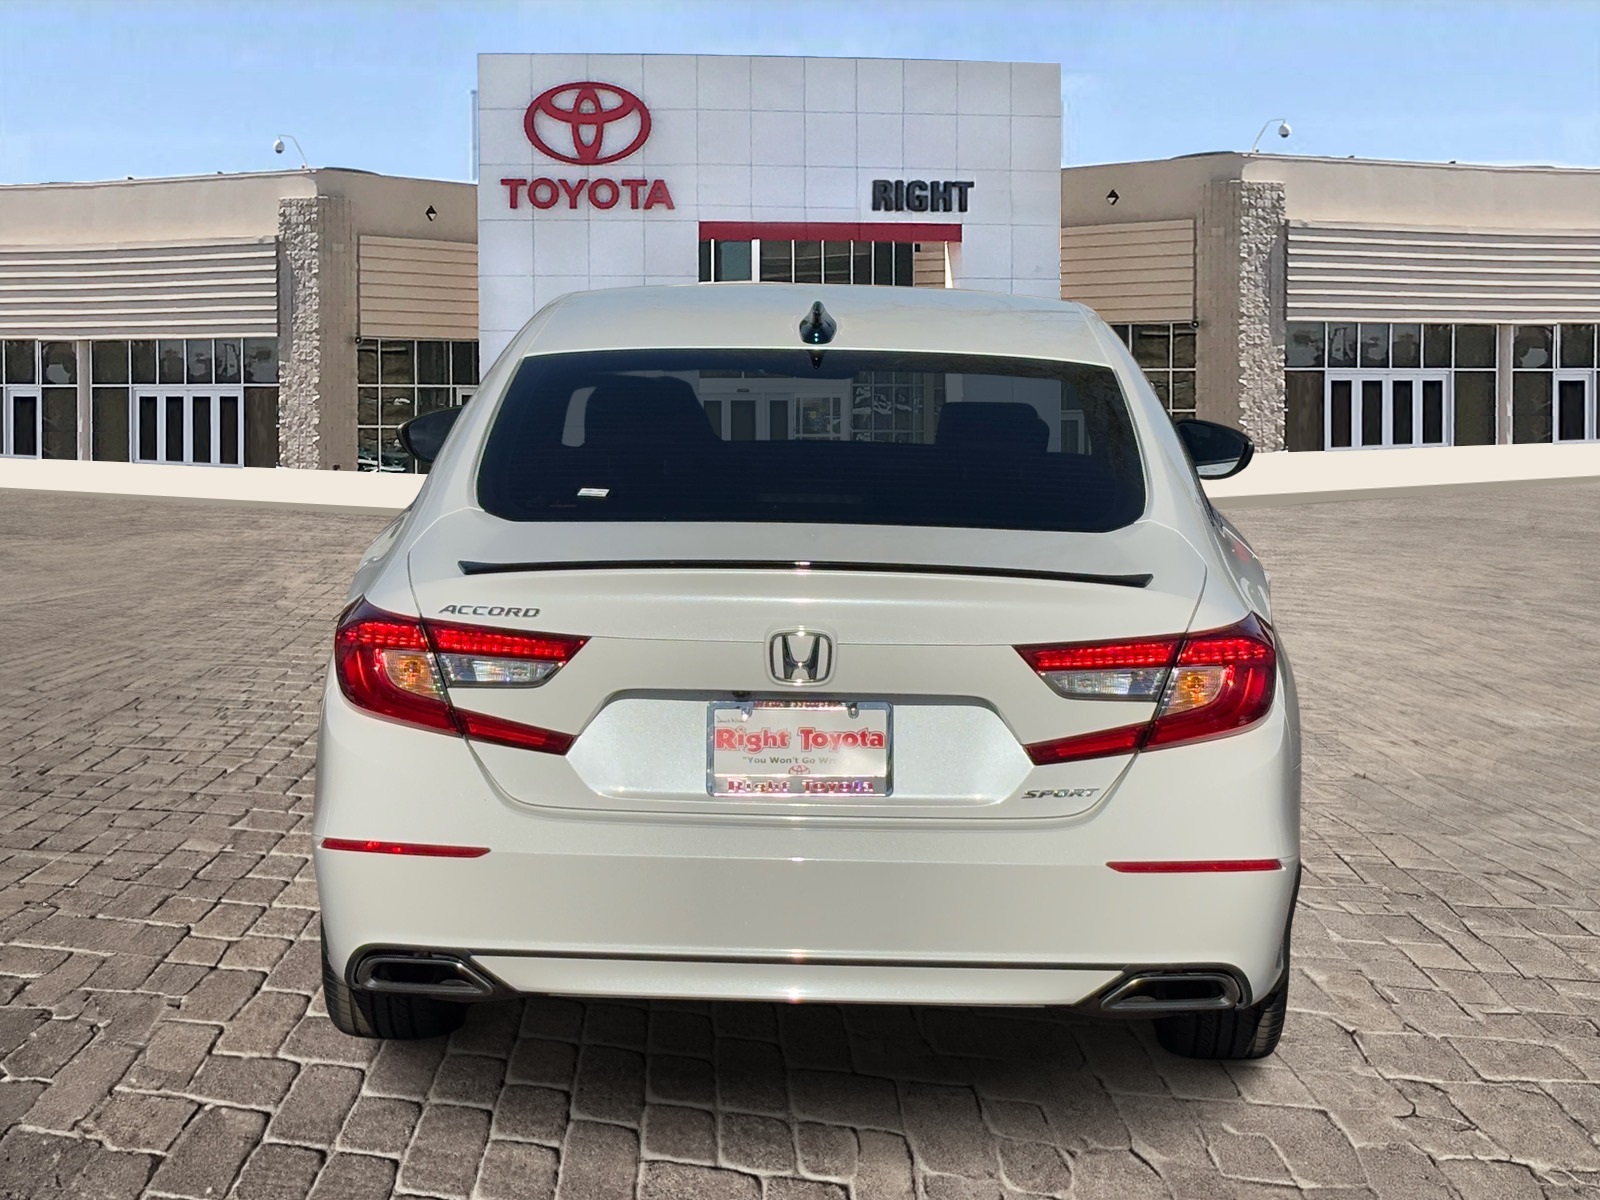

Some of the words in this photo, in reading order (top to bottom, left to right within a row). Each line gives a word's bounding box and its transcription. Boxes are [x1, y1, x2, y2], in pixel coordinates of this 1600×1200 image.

[500, 177, 675, 210] TOYOTA
[872, 179, 975, 212] RIGHT
[438, 604, 541, 618] ACCORD
[714, 727, 791, 753] Right
[797, 727, 886, 753] Toyota
[769, 756, 799, 764] Won't
[801, 756, 816, 764] Go
[802, 779, 874, 793] Toyota
[1021, 788, 1100, 799] SPORT
